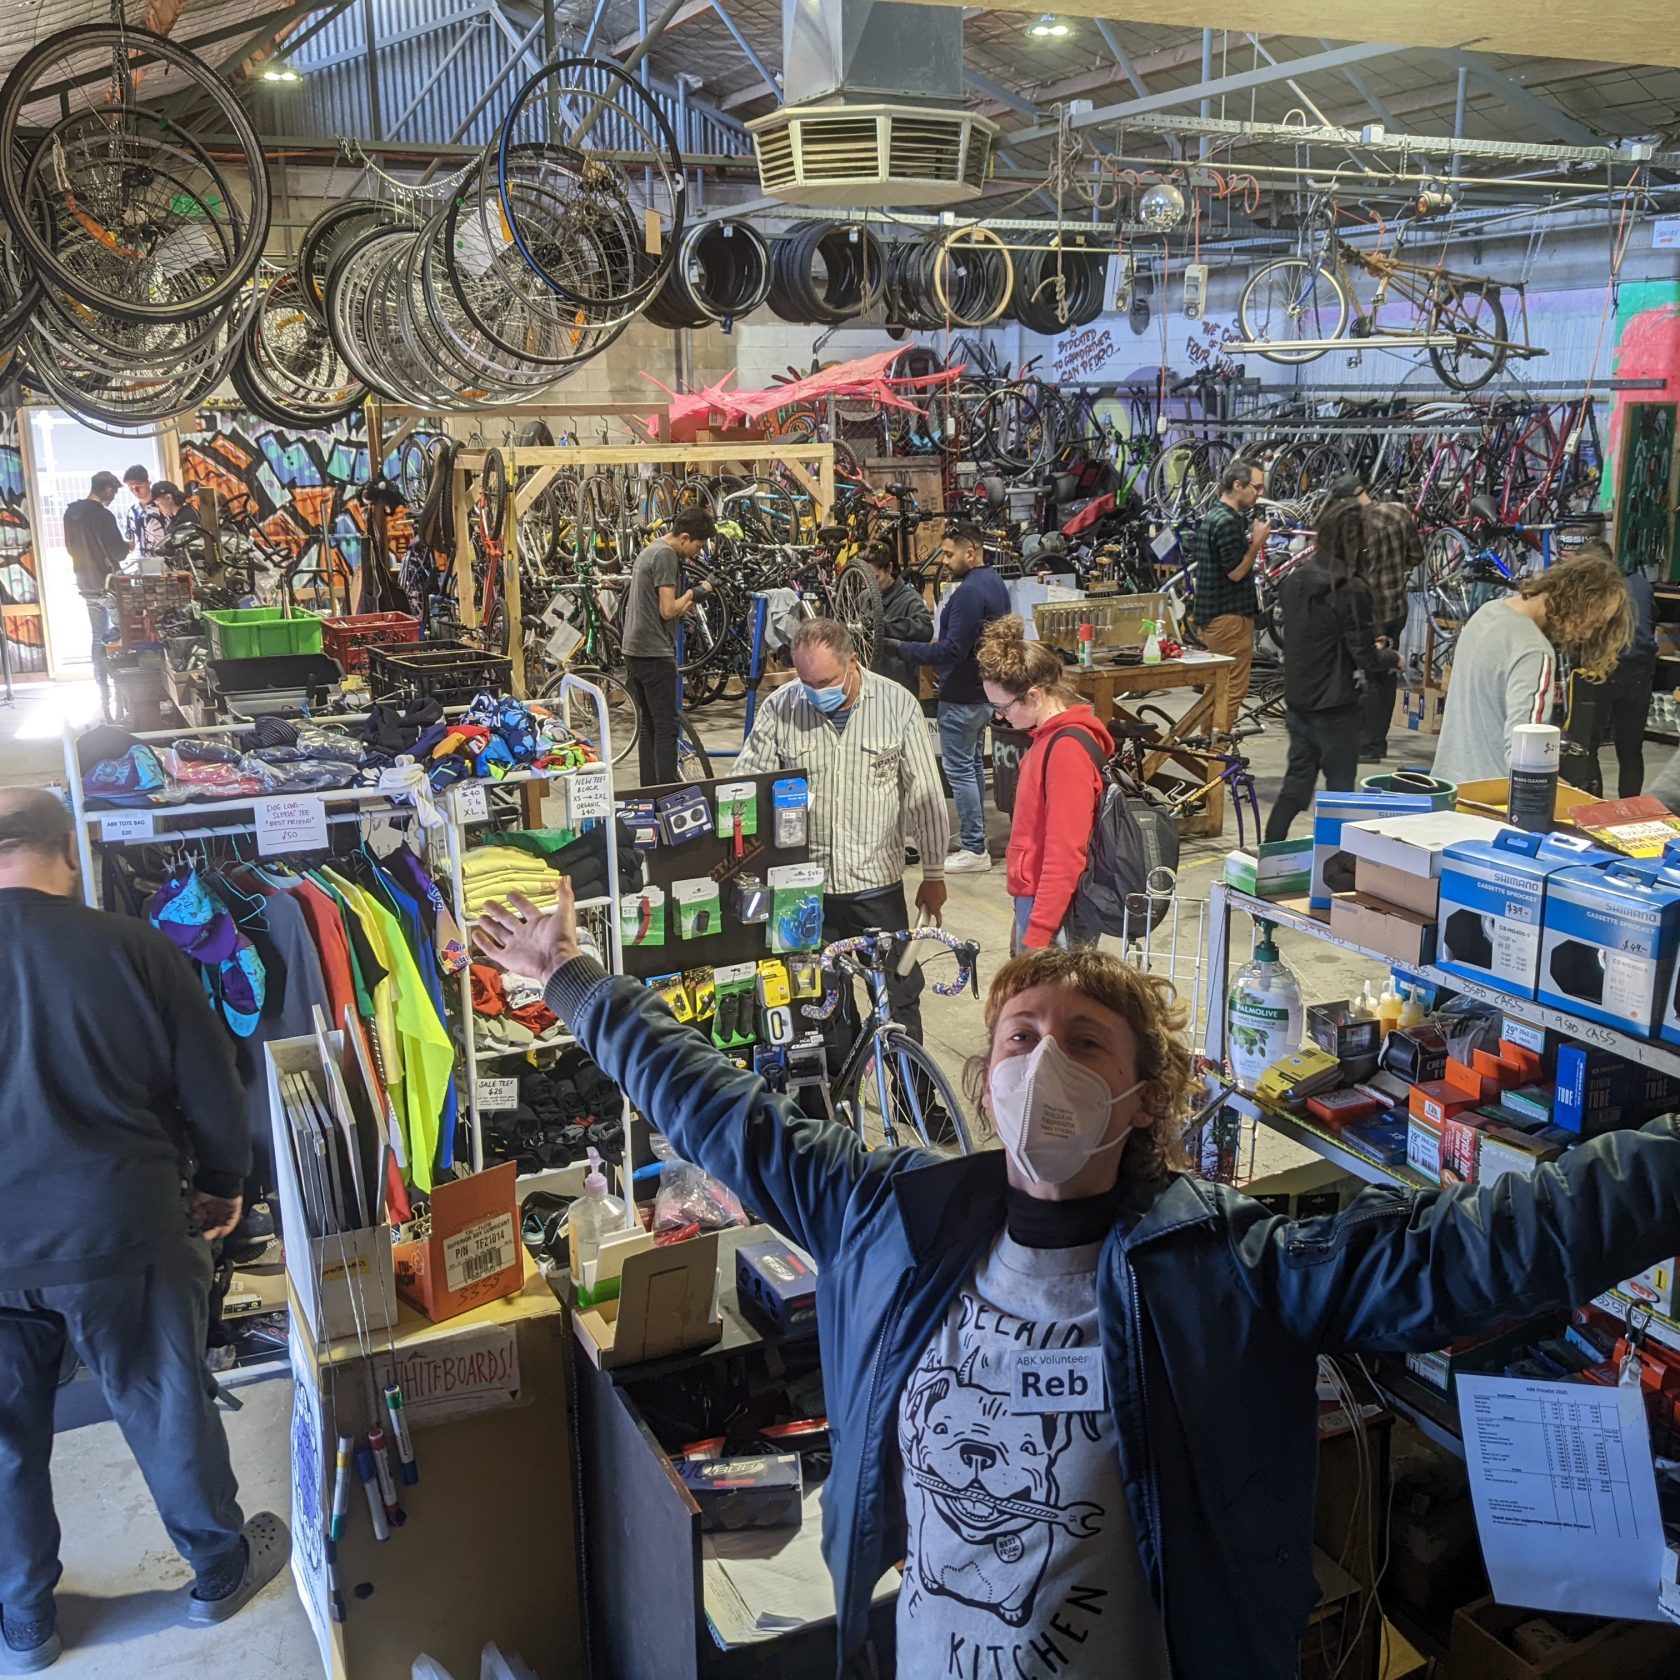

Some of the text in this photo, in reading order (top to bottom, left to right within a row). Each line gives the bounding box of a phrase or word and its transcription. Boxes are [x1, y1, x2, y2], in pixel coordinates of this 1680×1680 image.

[1052, 329, 1112, 372] TO GRANDFATHER
[1057, 328, 1098, 355] DEDICATED
[1186, 335, 1210, 366] FOUR
[877, 750, 900, 769] Paul
[575, 776, 591, 786] NEW
[577, 785, 600, 793] BLACK
[266, 804, 281, 813] DOG
[464, 808, 479, 817] XL
[581, 809, 596, 817] $40
[133, 819, 146, 827] BAG
[1494, 872, 1540, 892] SHIMANO
[1477, 881, 1538, 904] CASSETTE SPROCKET
[1605, 902, 1657, 923] SHIMANO
[1586, 911, 1655, 934] CASSETTE SPROCKET
[1408, 961, 1430, 977] CASS
[1236, 1003, 1279, 1018] PALMOLIVE
[1494, 991, 1525, 1013] CASS
[1586, 1027, 1617, 1046] CASS
[478, 1080, 497, 1089] SALE
[487, 1088, 503, 1096] $25
[1557, 1086, 1574, 1107] TUBE
[1588, 1088, 1611, 1109] TUBE
[447, 1235, 473, 1250] SUPERIOR
[483, 1218, 511, 1233] LUBRICANT
[455, 1230, 505, 1260] P/N TF21014
[1629, 1281, 1655, 1299] CST
[1016, 1354, 1090, 1367] ABK Volunteer
[1021, 1369, 1089, 1398] Reb
[999, 1537, 1016, 1549] BEST
[1000, 1545, 1021, 1556] FRIEND
[949, 1585, 1108, 1680] KITCHEN
